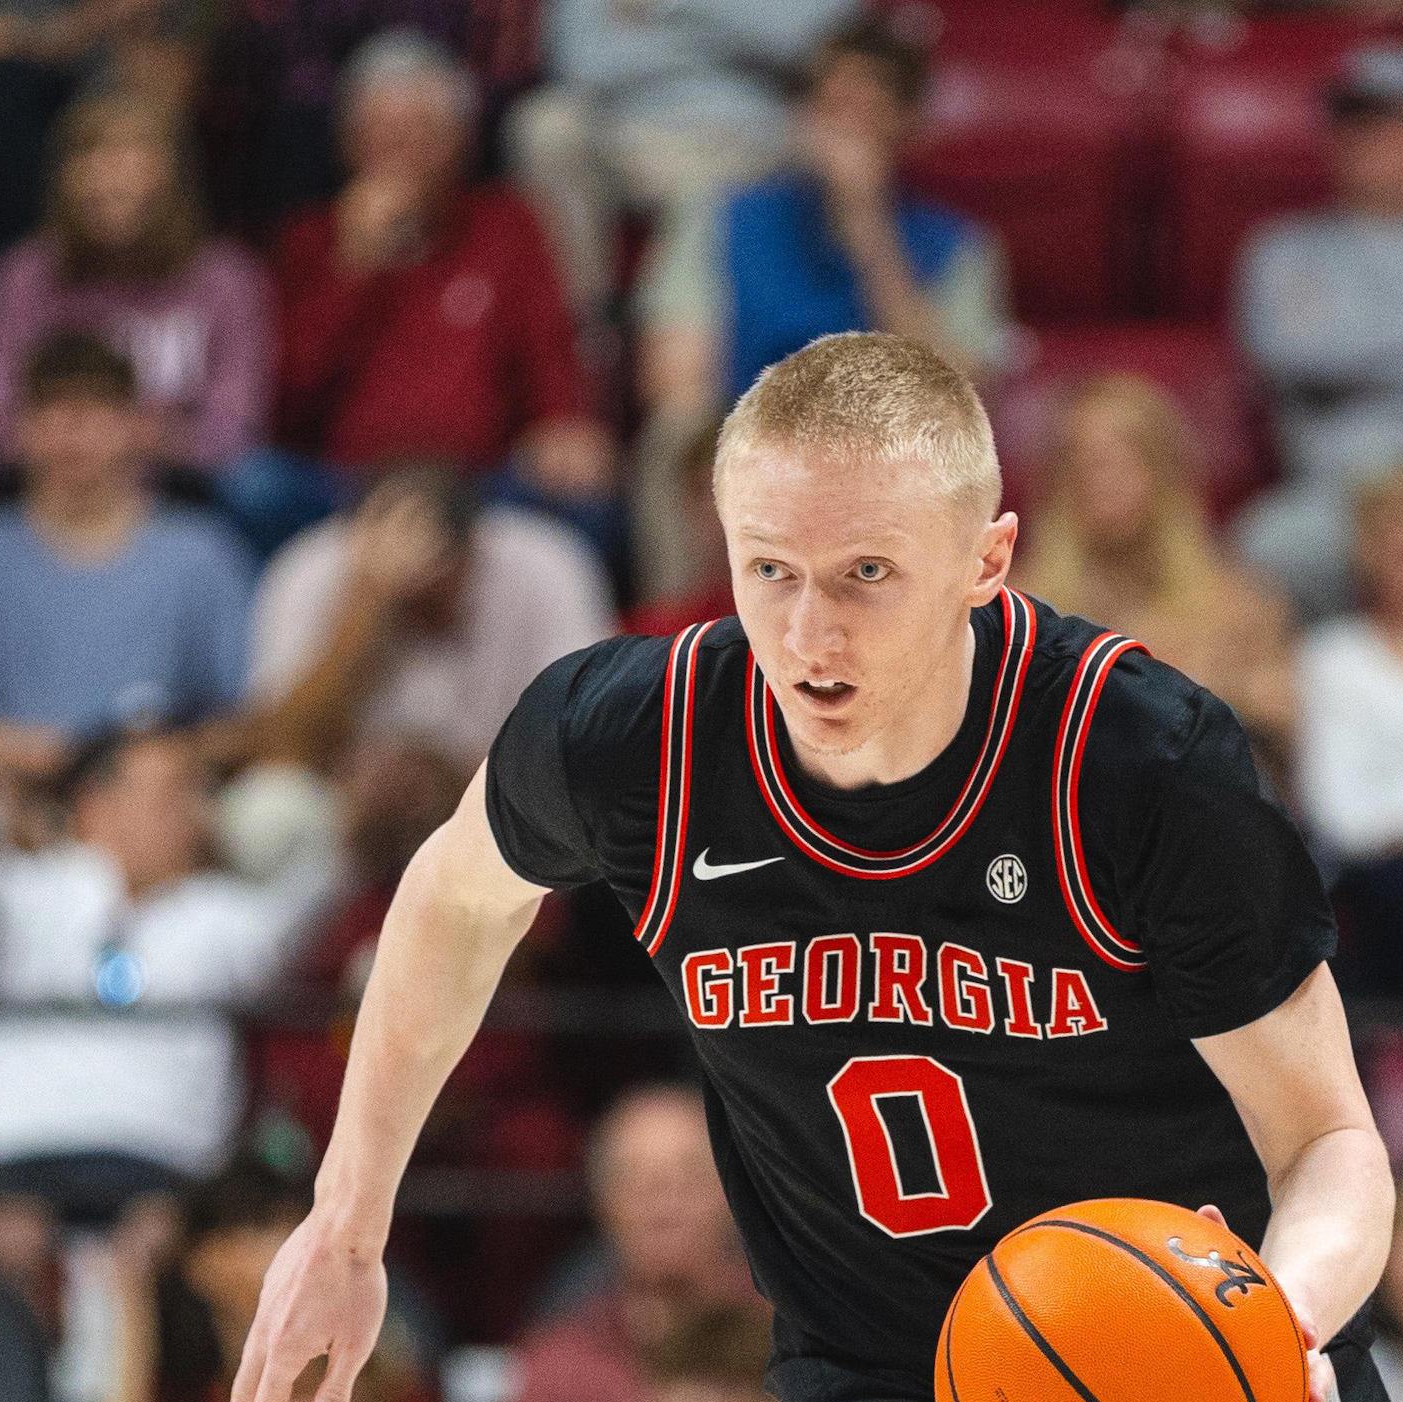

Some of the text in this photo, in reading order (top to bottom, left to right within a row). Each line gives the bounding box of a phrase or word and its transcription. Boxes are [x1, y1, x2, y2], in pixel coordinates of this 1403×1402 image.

[989, 857, 1025, 900] SEC
[681, 932, 1109, 1040] GEORGIA
[826, 1054, 994, 1239] 0
